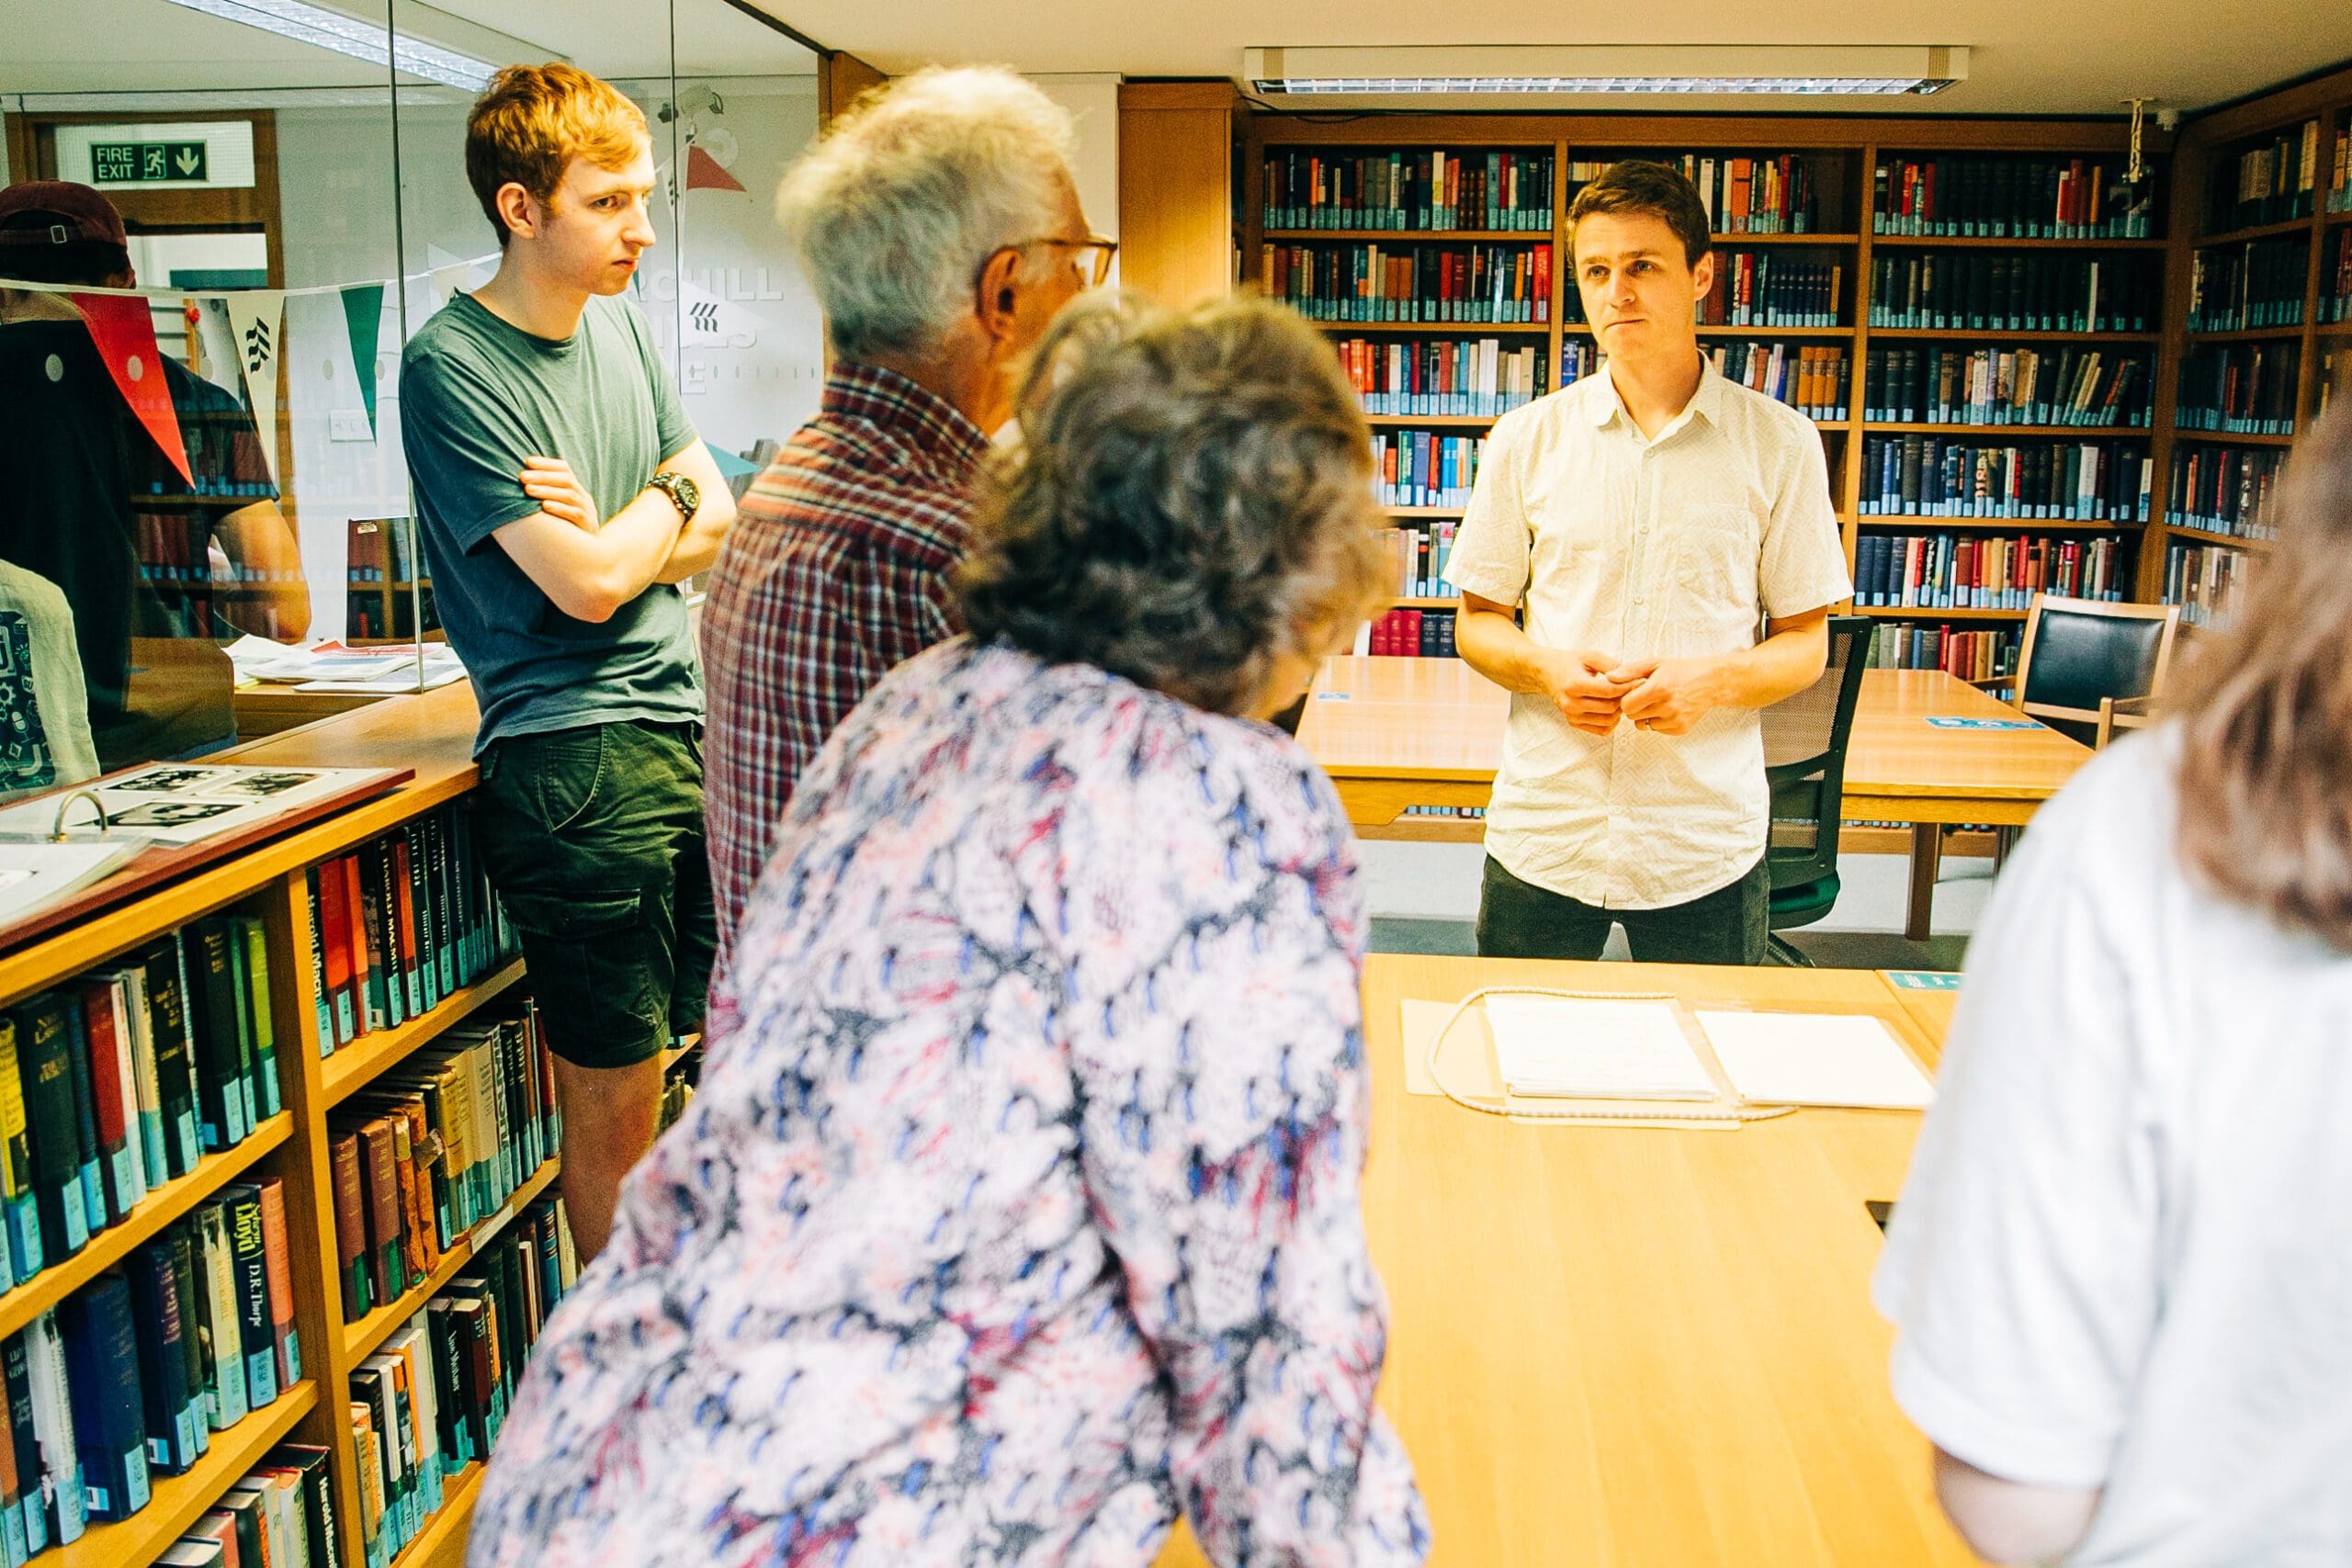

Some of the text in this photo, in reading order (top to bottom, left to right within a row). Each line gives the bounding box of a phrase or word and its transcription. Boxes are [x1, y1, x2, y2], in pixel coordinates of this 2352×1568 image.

[96, 147, 134, 162] FIRE
[97, 164, 134, 179] EXIT
[628, 266, 785, 303] RCHILL
[308, 894, 320, 950] Harold
[233, 1201, 256, 1254] Lloyd
[248, 1290, 264, 1328] Thorpe
[318, 1475, 333, 1526] Harold
